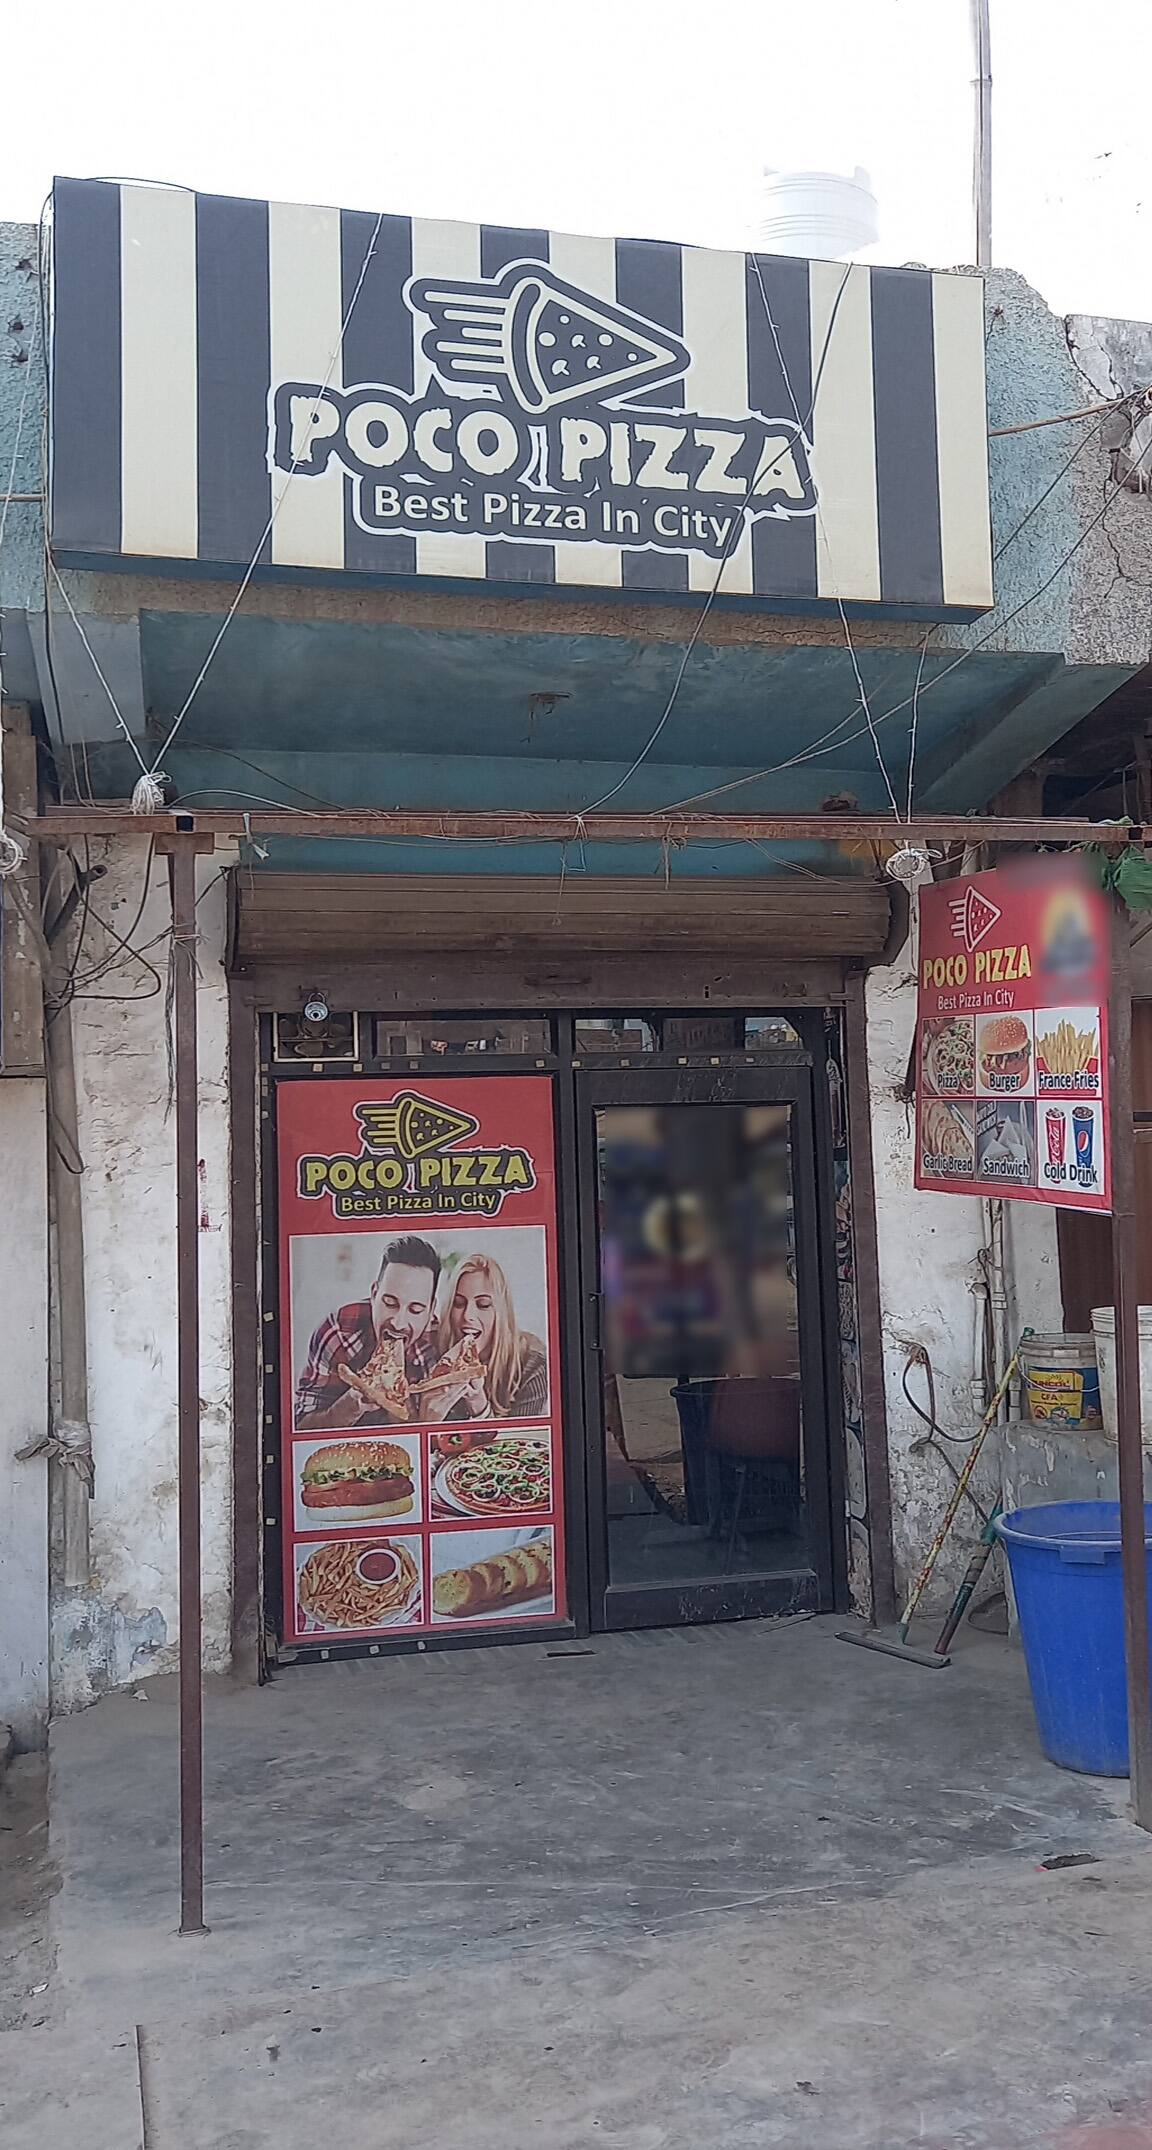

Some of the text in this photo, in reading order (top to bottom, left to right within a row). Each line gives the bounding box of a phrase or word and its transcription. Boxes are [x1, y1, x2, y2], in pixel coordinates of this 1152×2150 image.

[289, 395, 806, 498] POCO PIZZA
[374, 485, 732, 547] Best Pizza In City
[923, 944, 1032, 990] POCO PIZZA
[938, 989, 1014, 1010] Best Pizza In City
[937, 1073, 958, 1088] Pizza
[989, 1073, 1020, 1091] Burger
[1039, 1071, 1099, 1088] France Fries
[306, 1155, 528, 1191] POCO PIZZA
[923, 1155, 973, 1172] Garlic Bread
[983, 1158, 1029, 1176] Sandwich
[1044, 1163, 1098, 1183] Cold Drink
[341, 1193, 496, 1211] Best Pizza In City
